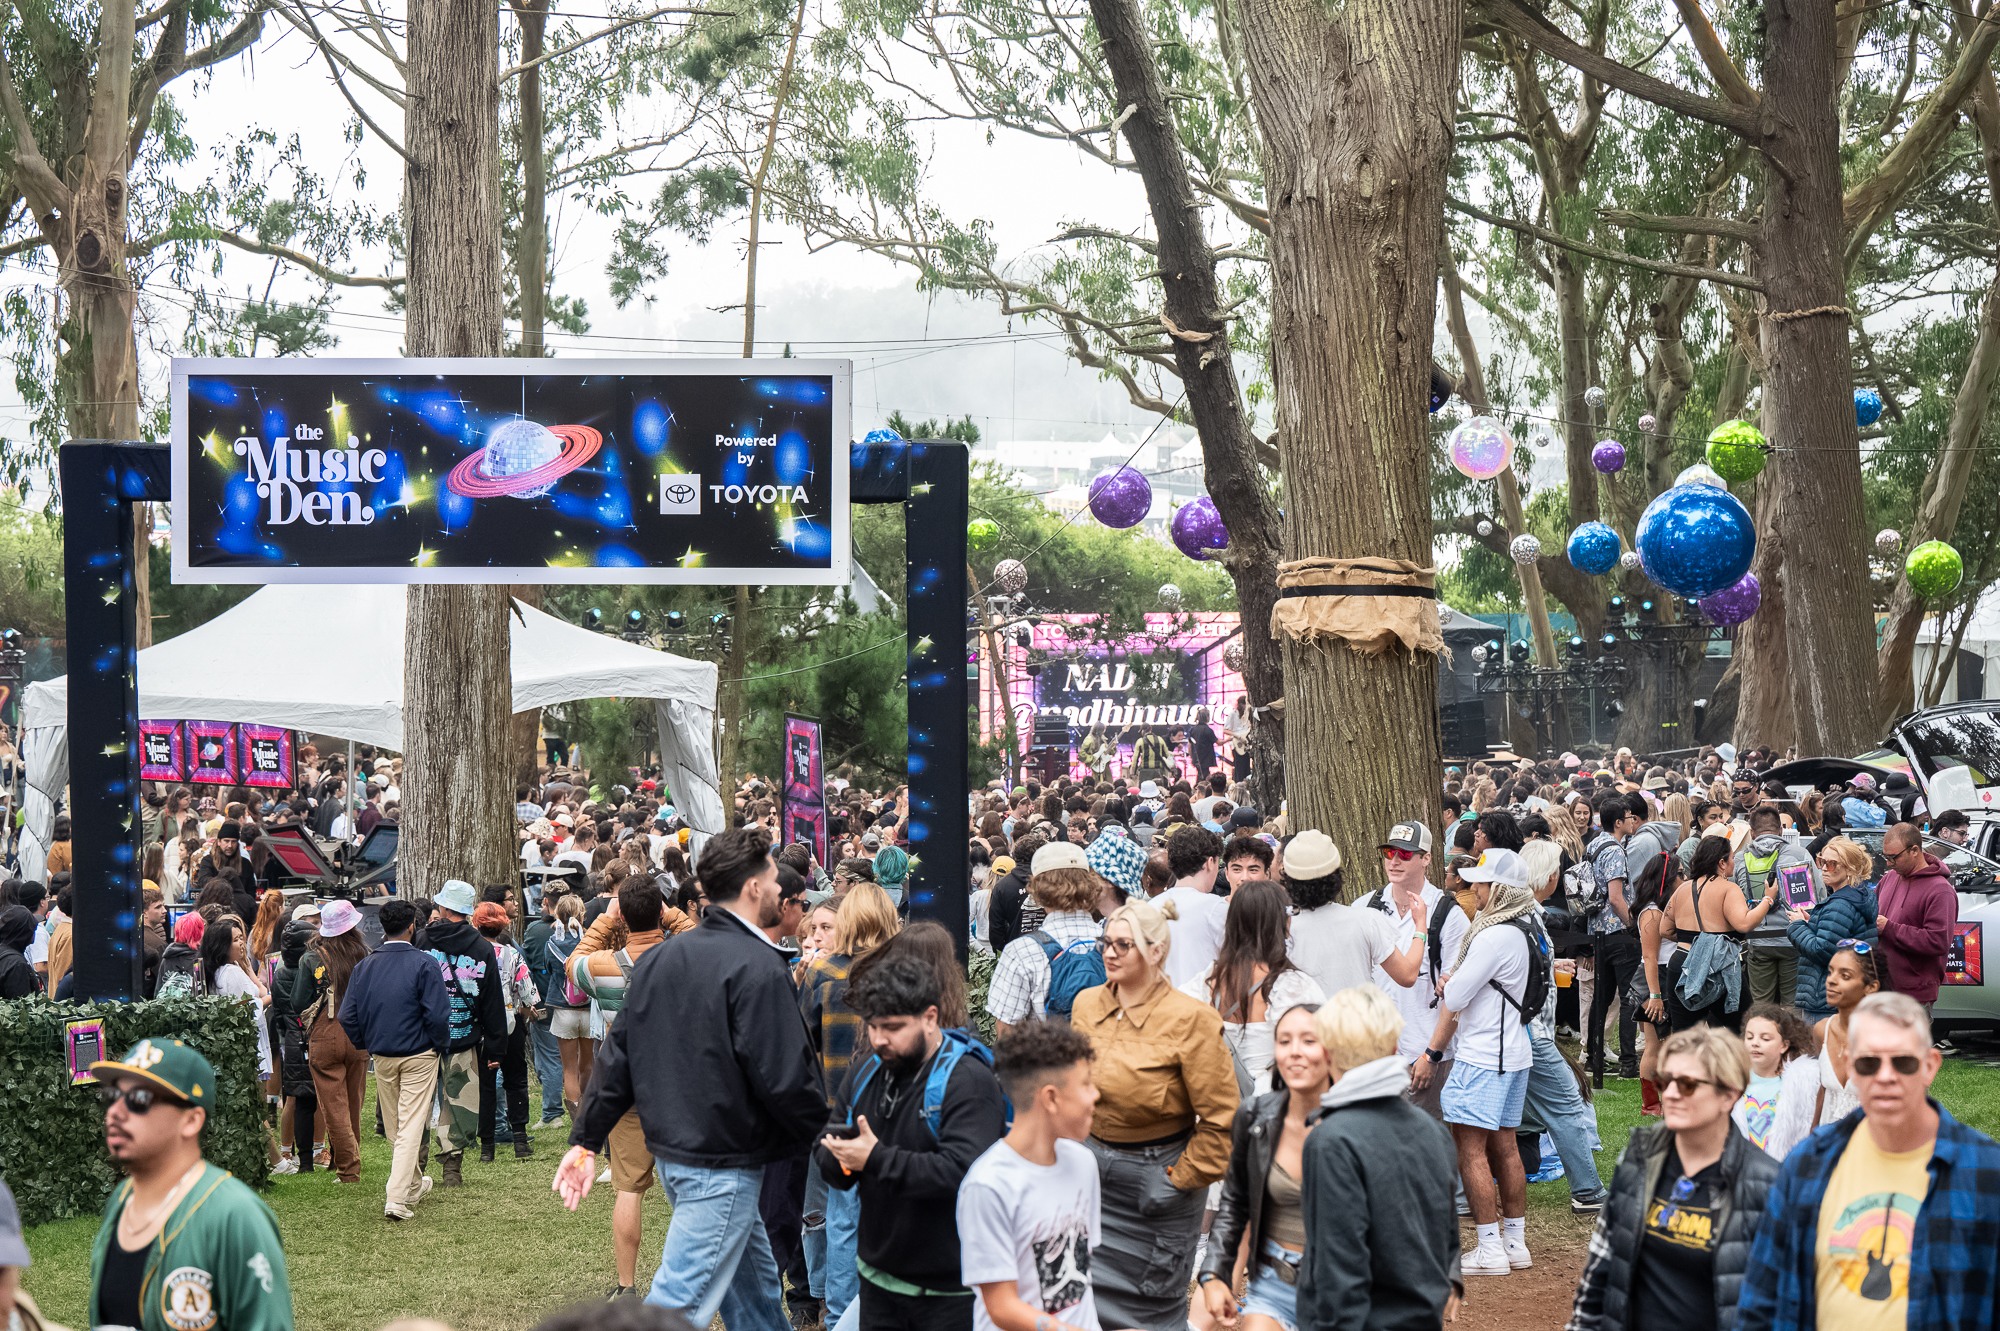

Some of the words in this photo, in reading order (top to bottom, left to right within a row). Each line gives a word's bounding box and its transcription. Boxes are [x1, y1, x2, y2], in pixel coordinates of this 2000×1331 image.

[295, 423, 324, 441] the
[715, 433, 777, 447] Powered
[233, 435, 387, 483] Music
[737, 451, 756, 467] by
[709, 484, 810, 504] TOYOTA
[1791, 885, 1807, 894] EXIT
